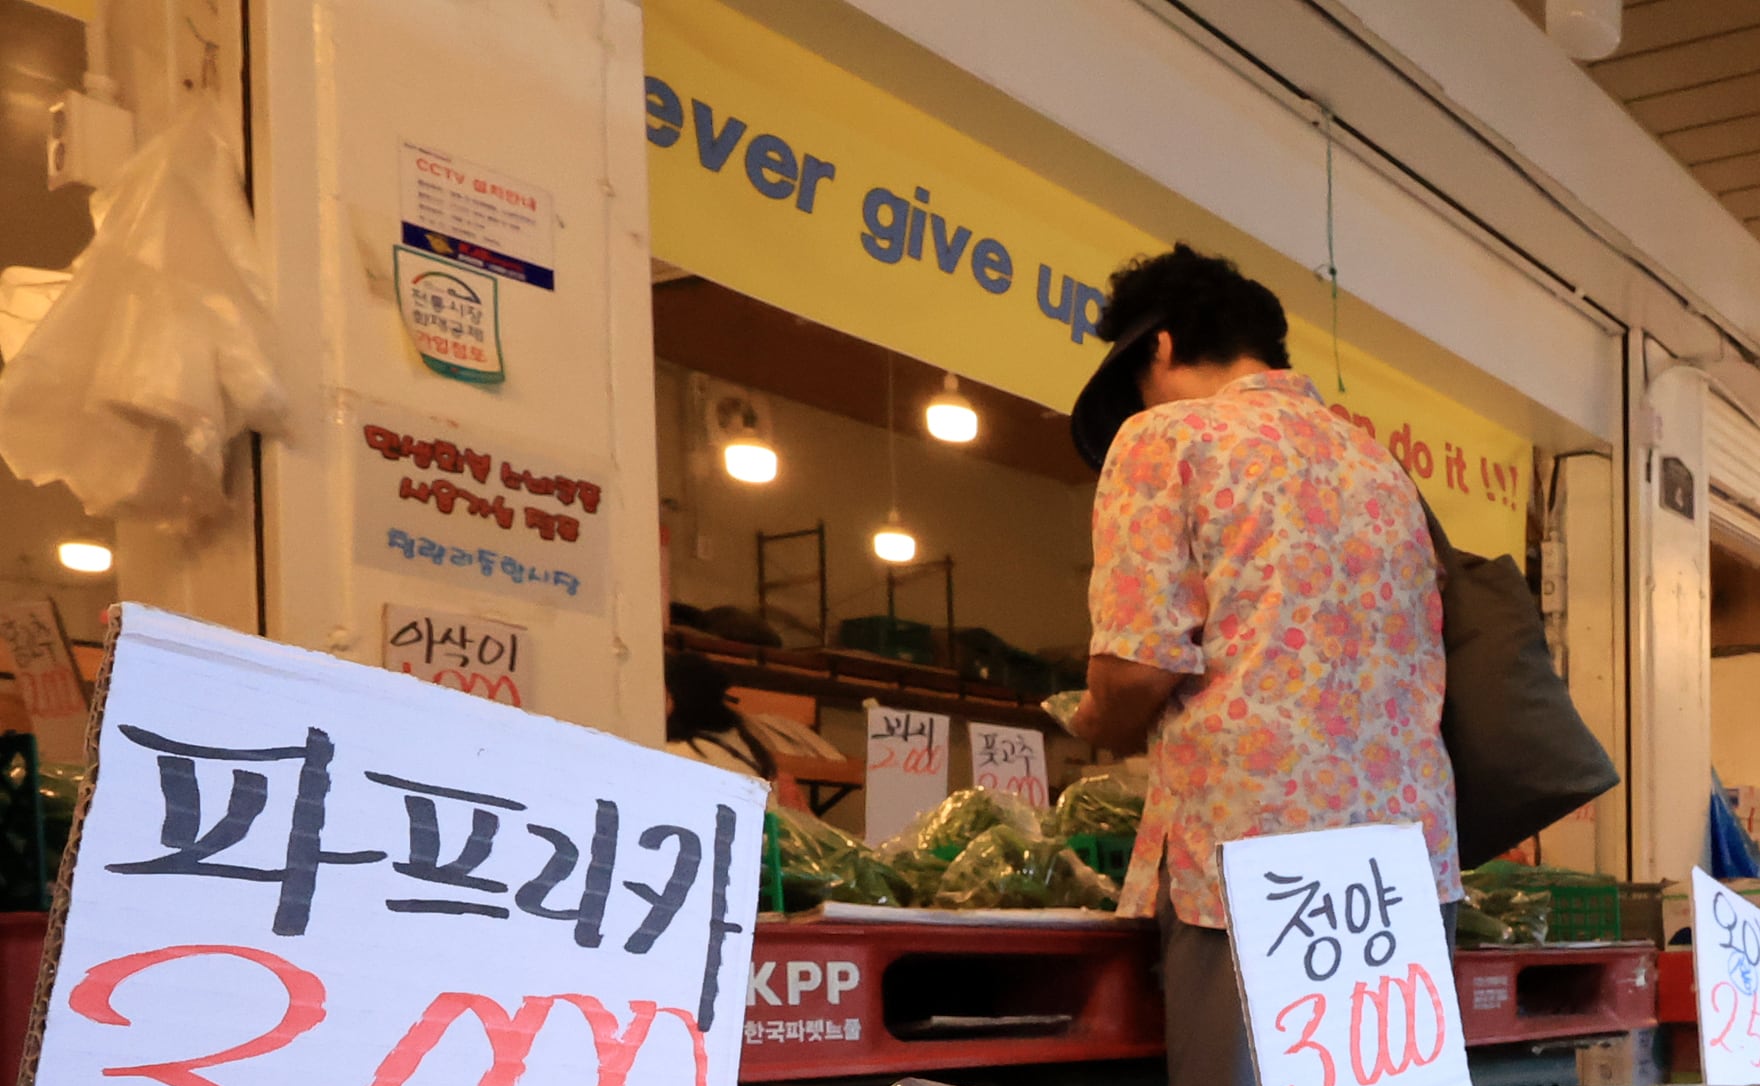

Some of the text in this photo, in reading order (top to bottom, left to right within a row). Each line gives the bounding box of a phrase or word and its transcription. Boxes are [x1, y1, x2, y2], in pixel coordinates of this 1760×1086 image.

[416, 157, 466, 185] CCTV
[860, 185, 1014, 295] give
[1036, 262, 1108, 345] up
[1389, 422, 1434, 480] do
[1445, 442, 1470, 495] it
[399, 476, 515, 530] 사용가능
[390, 616, 518, 673] 아삭이
[104, 725, 743, 1033] 파프리카
[1263, 857, 1403, 982] 청양
[745, 961, 861, 1006] KPP
